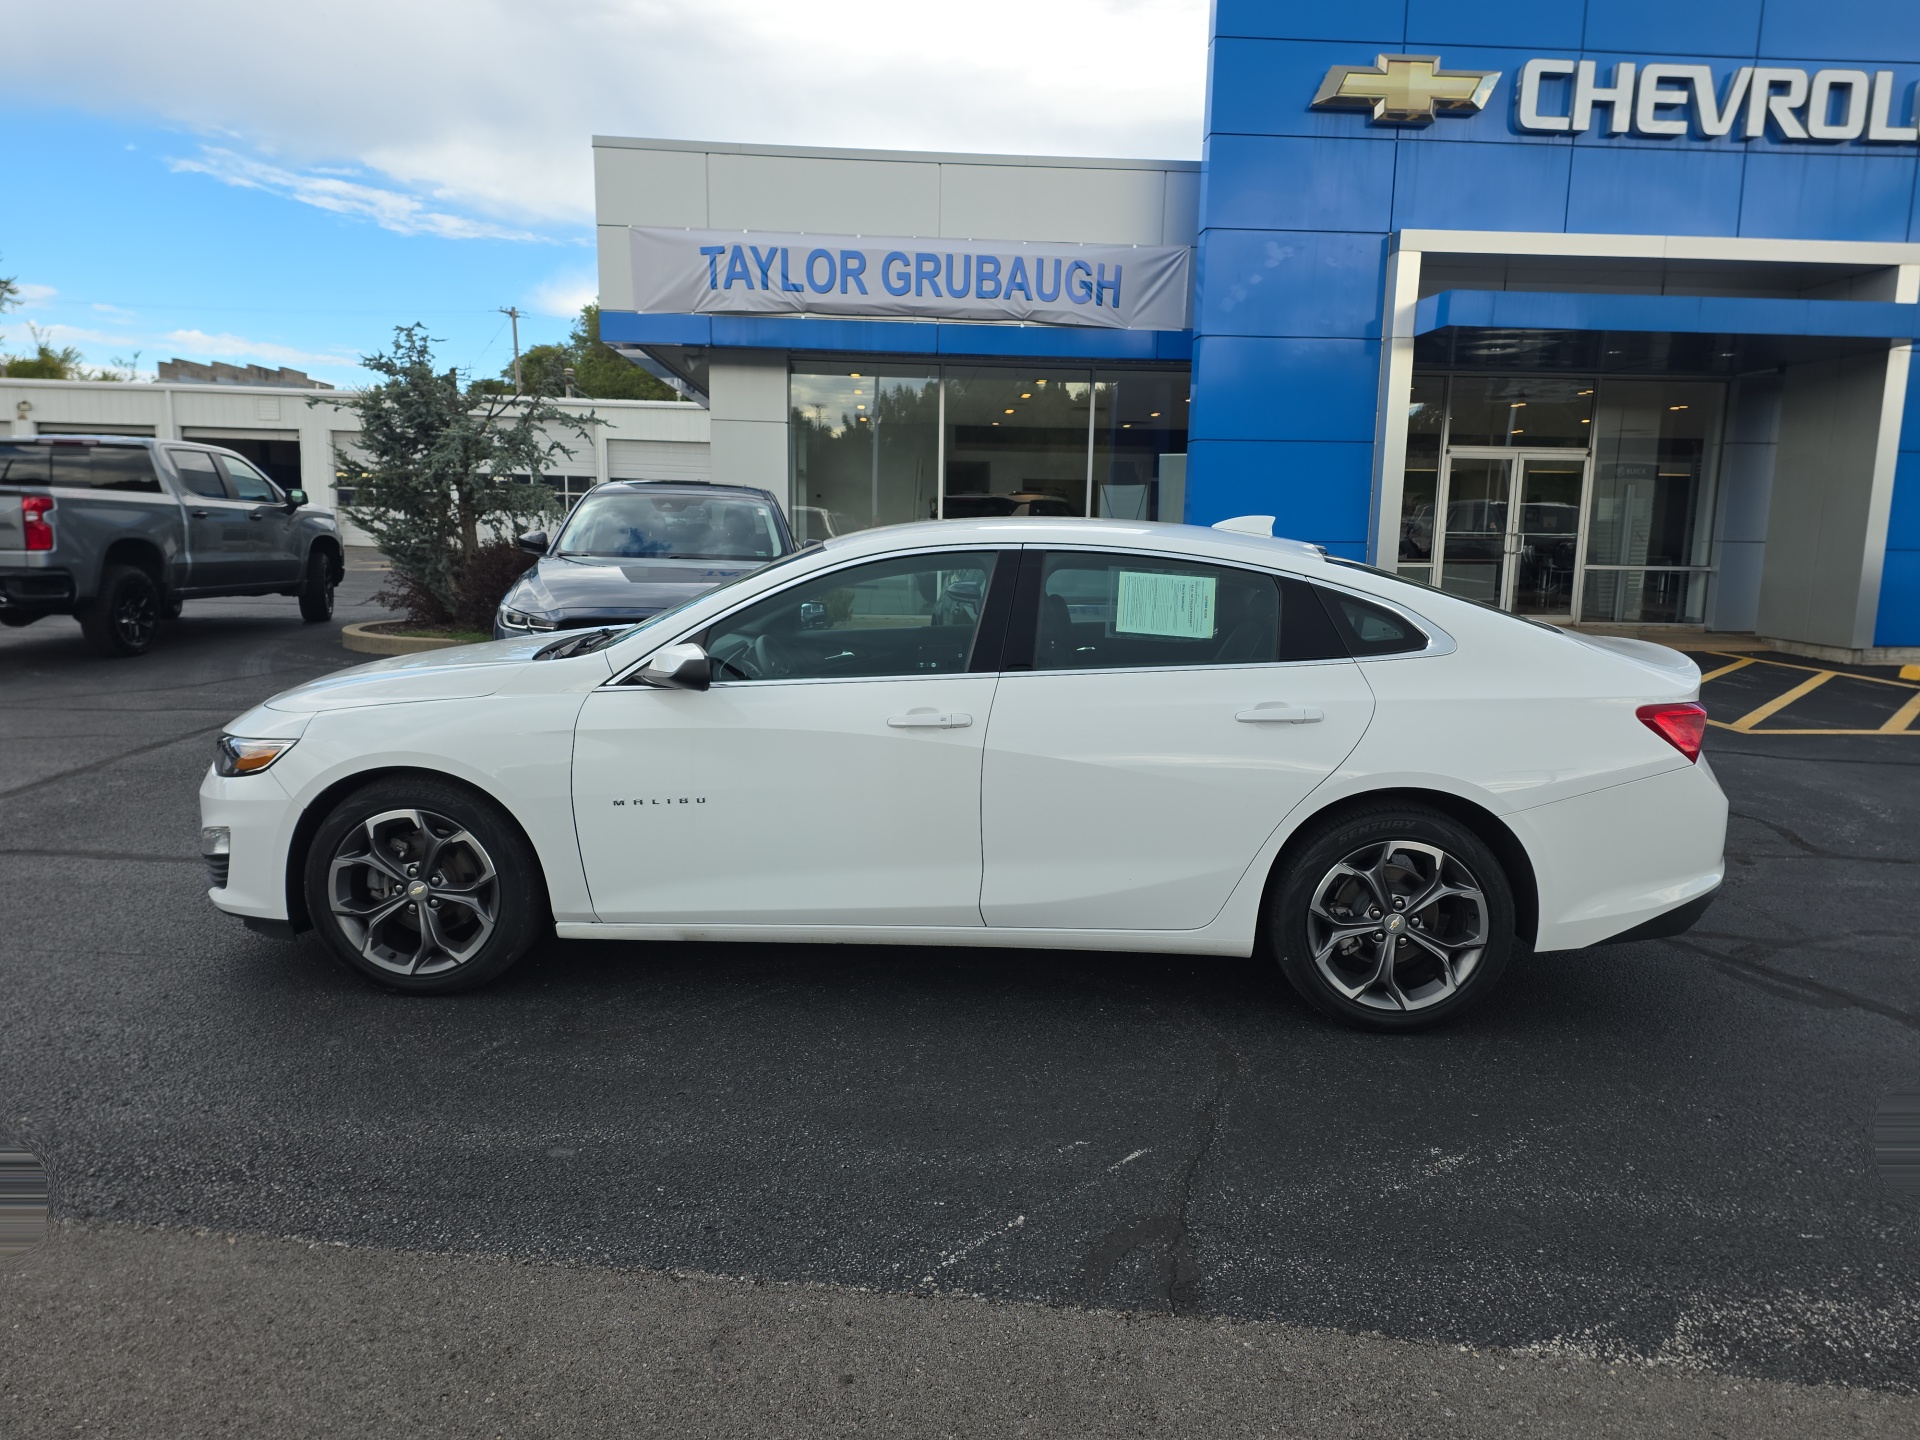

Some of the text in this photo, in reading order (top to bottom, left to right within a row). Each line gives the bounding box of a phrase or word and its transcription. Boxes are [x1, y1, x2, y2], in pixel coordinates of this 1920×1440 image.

[1517, 58, 1920, 142] CHEVROL
[700, 245, 1123, 308] TAYLOR GRUBAUGH
[1625, 467, 1647, 475] BUICK
[385, 788, 465, 808] SENTURY
[612, 797, 707, 806] MALIBU
[1338, 820, 1417, 843] SENTURY
